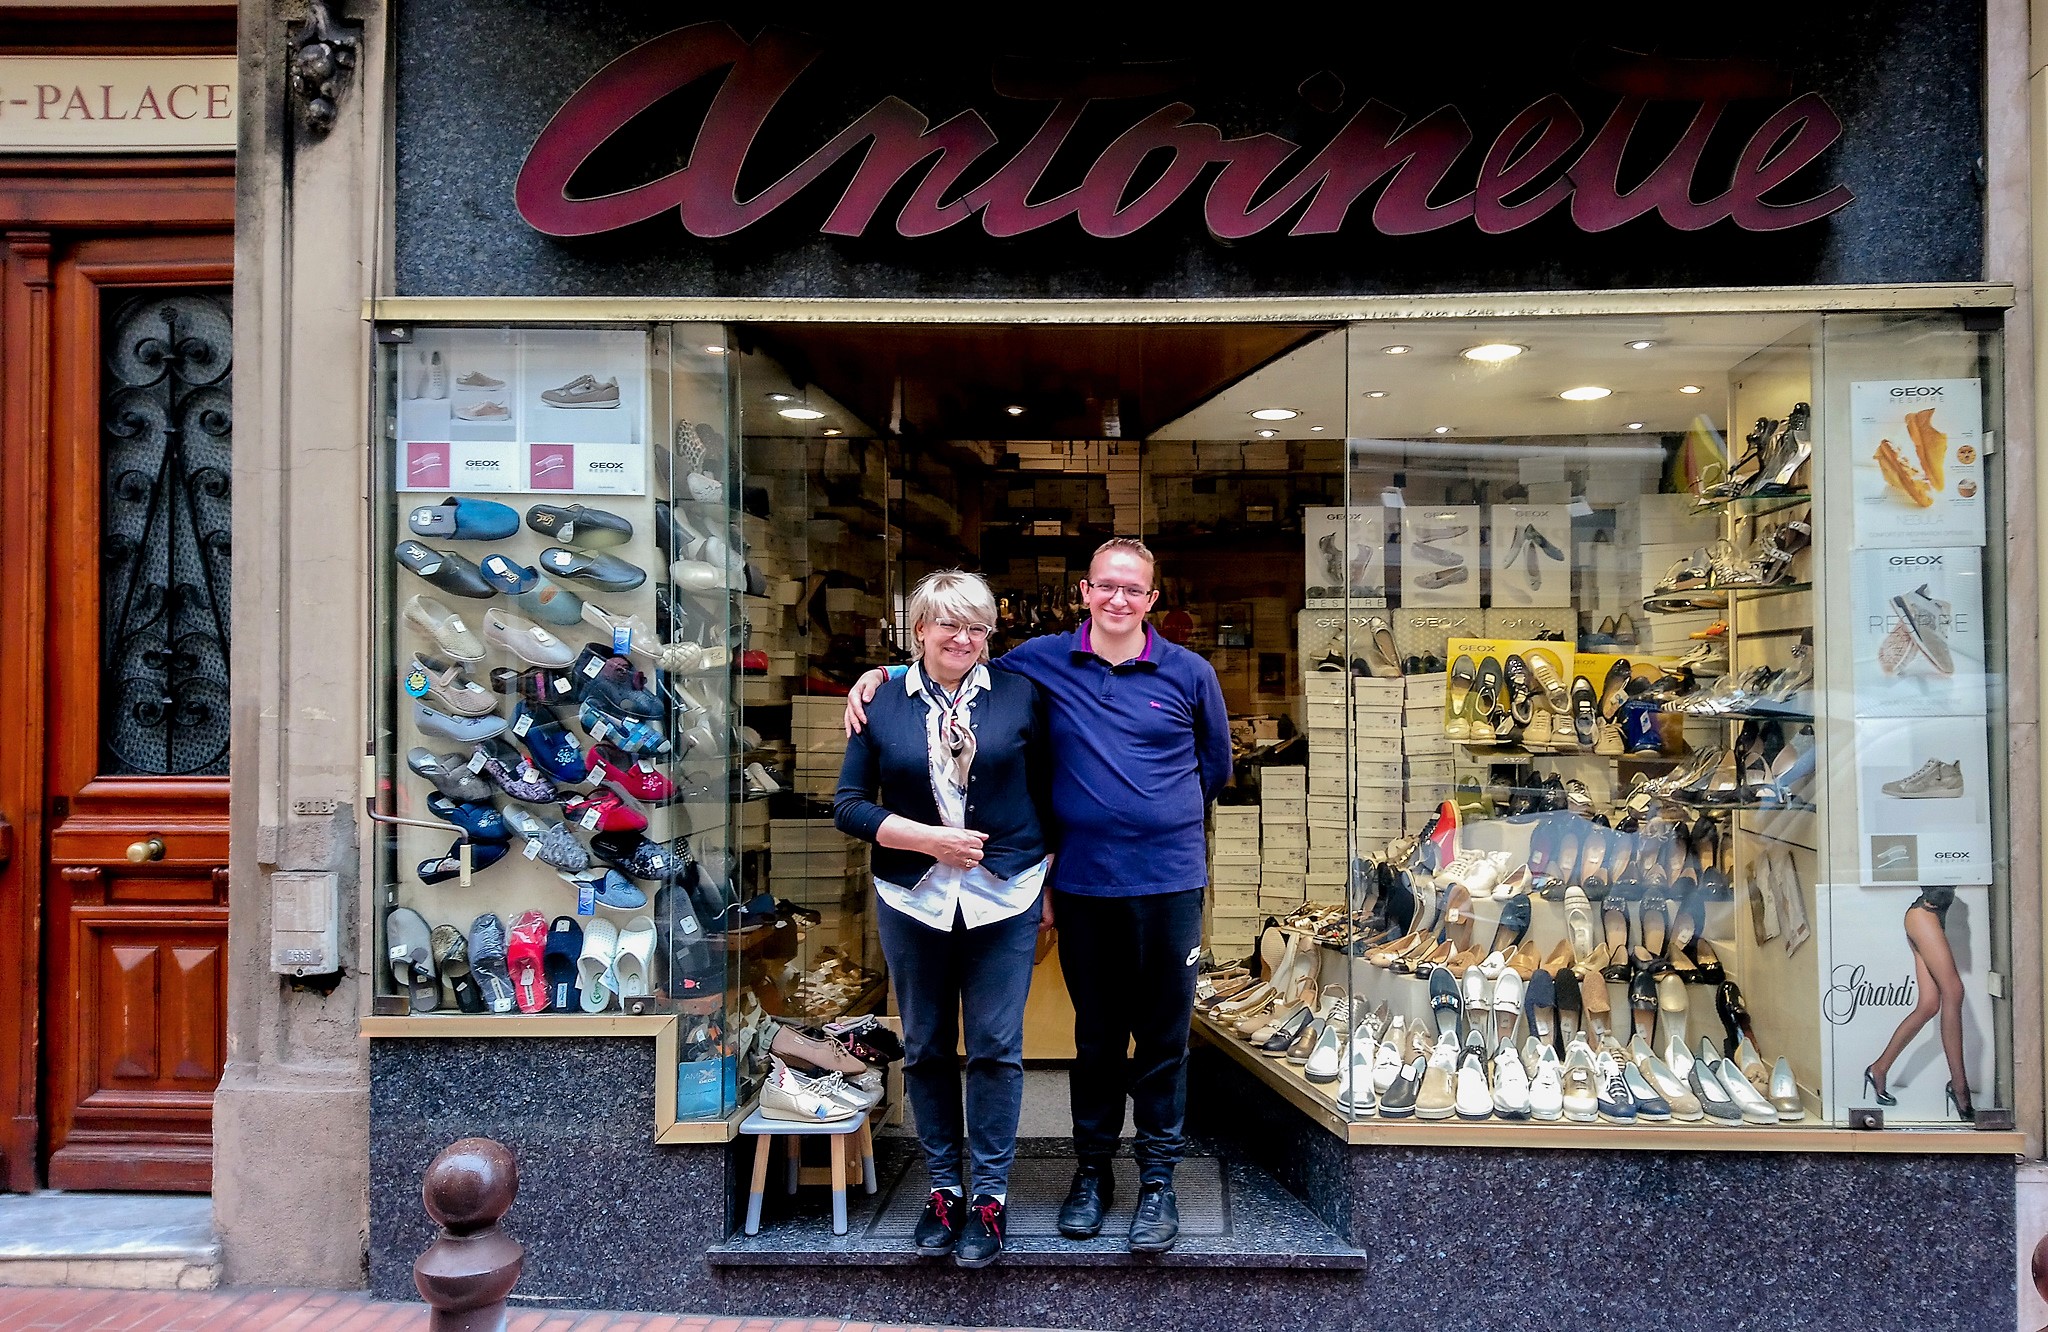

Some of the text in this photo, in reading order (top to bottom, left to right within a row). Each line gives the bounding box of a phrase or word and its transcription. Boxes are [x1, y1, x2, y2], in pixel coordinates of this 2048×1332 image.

[0, 84, 233, 120] -PALACE
[514, 19, 1857, 240] Antoinette
[1890, 387, 1944, 397] GEOX
[465, 459, 500, 467] GEOX
[589, 461, 624, 469] GEOX
[1326, 513, 1362, 521] GEOX
[1515, 510, 1549, 518] GEOX
[1889, 556, 1943, 566] GEOX
[1458, 644, 1496, 652] GEOX
[1934, 851, 1970, 859] GEOX
[1823, 964, 1915, 1026] Girardi
